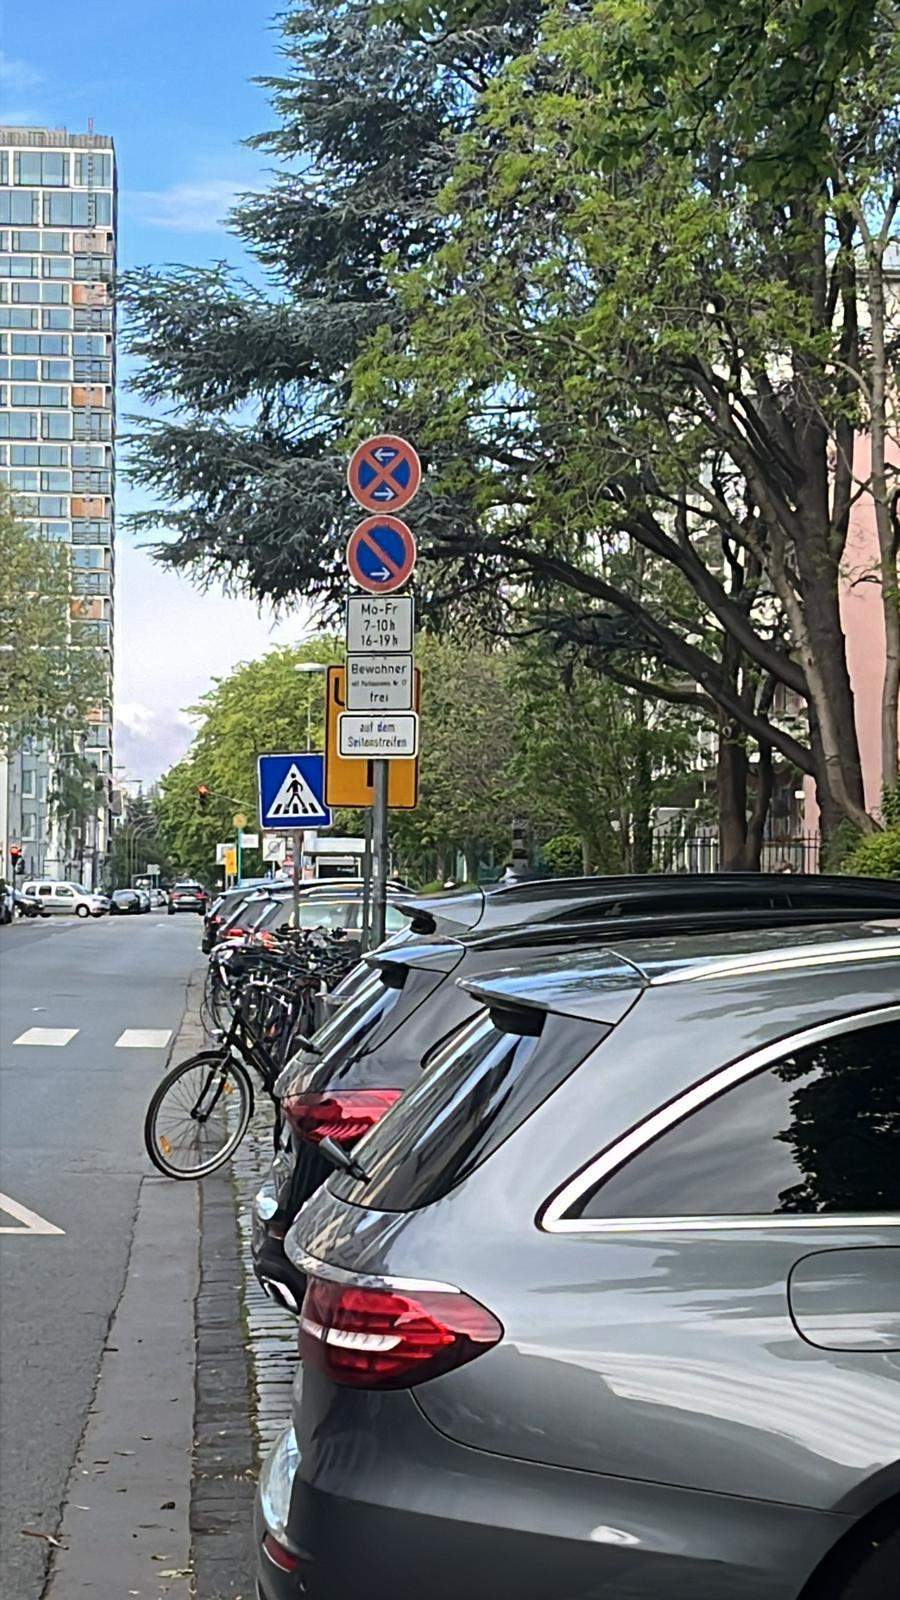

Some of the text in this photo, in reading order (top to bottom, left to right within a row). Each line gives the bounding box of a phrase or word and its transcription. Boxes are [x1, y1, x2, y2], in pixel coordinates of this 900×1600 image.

[361, 603, 398, 615] Mo-Fr
[352, 663, 407, 674] Bewohner
[370, 692, 389, 702] frei
[360, 722, 396, 733] auf dem
[348, 736, 407, 747] Seitenstreifen
